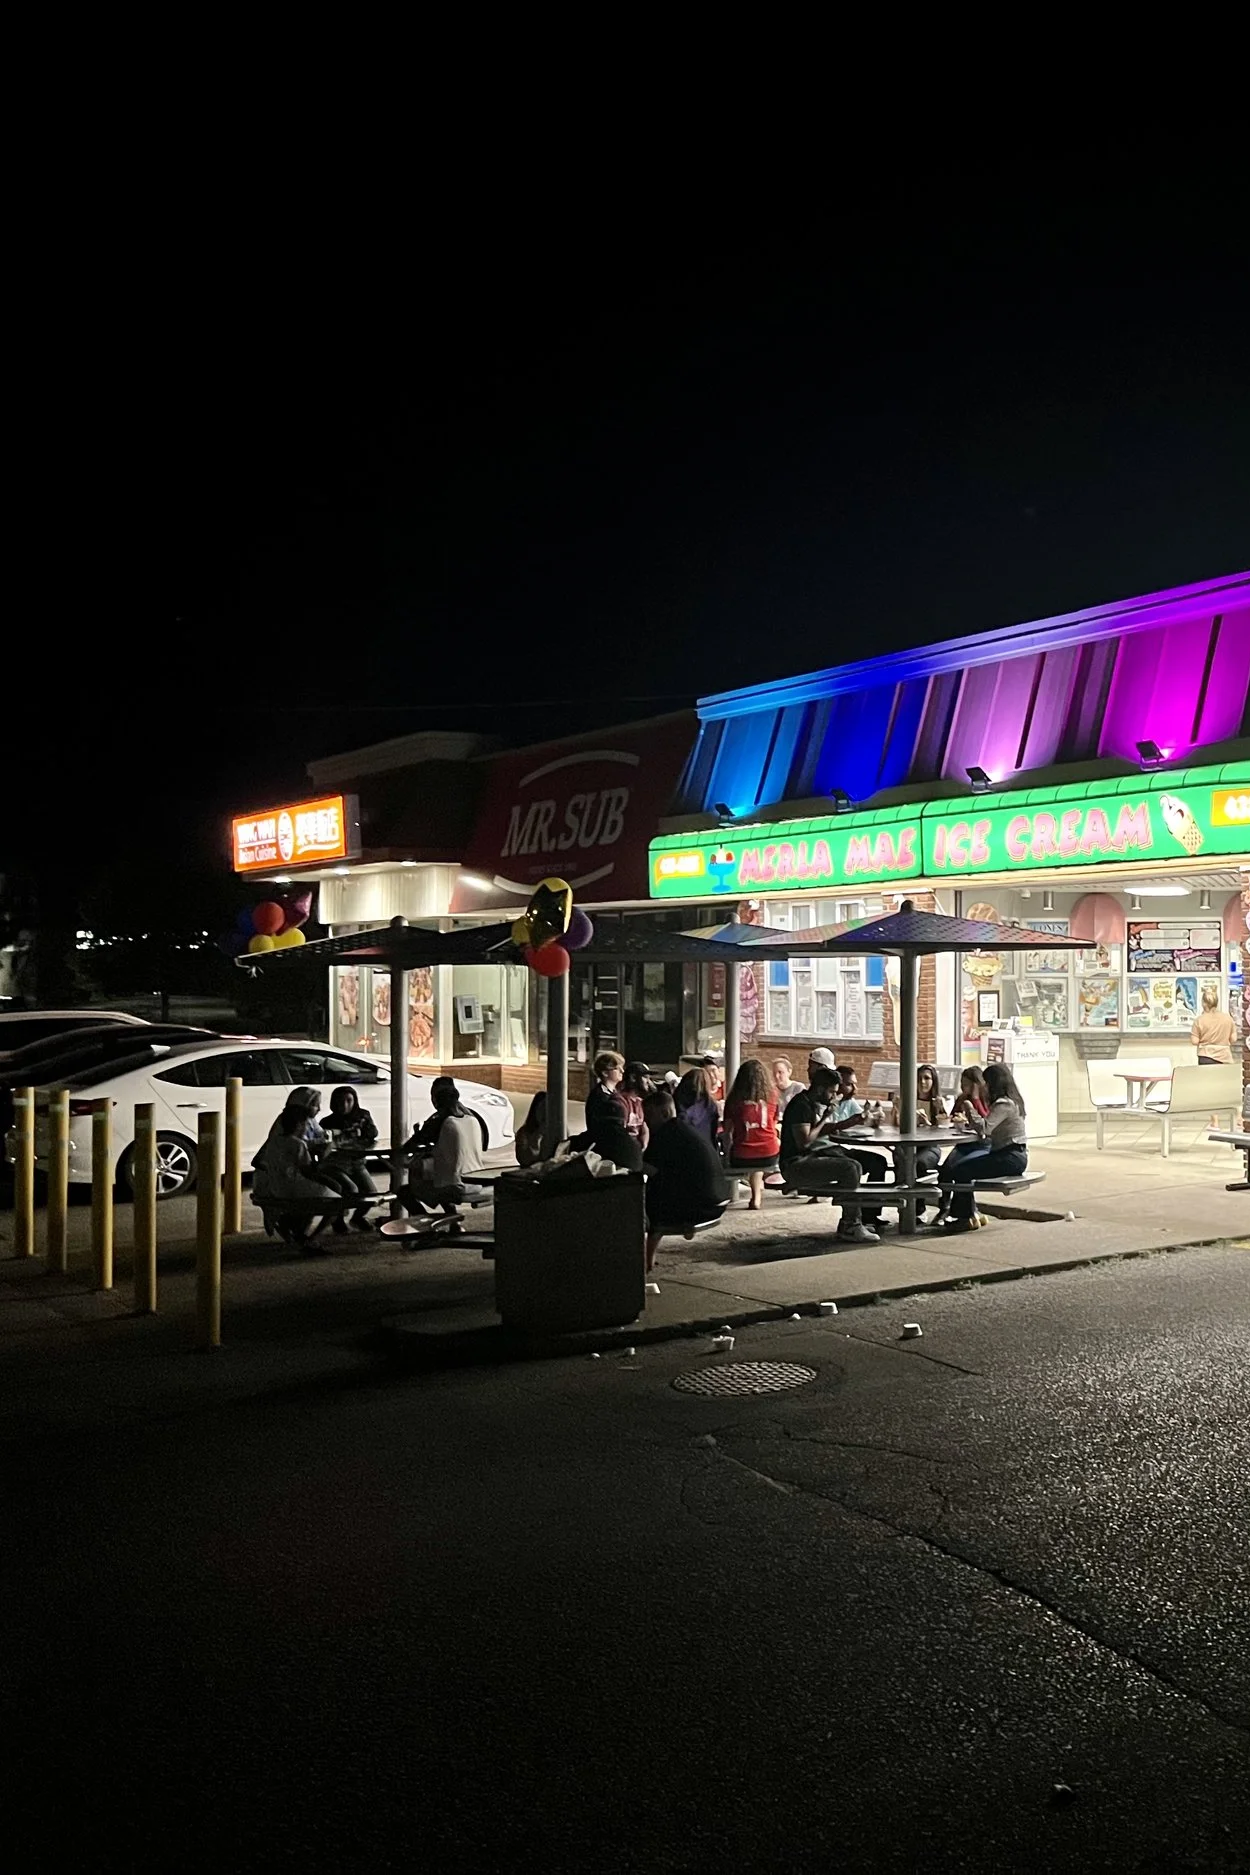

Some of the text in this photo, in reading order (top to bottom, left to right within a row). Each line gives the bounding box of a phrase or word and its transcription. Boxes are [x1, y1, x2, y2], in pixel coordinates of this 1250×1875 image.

[501, 786, 630, 857] MR.SUB
[738, 840, 834, 885] MERLA
[844, 827, 916, 875] MAE
[933, 819, 991, 870] ICE
[1004, 801, 1153, 862] CREAM
[1016, 1050, 1056, 1060] THANK YOU
